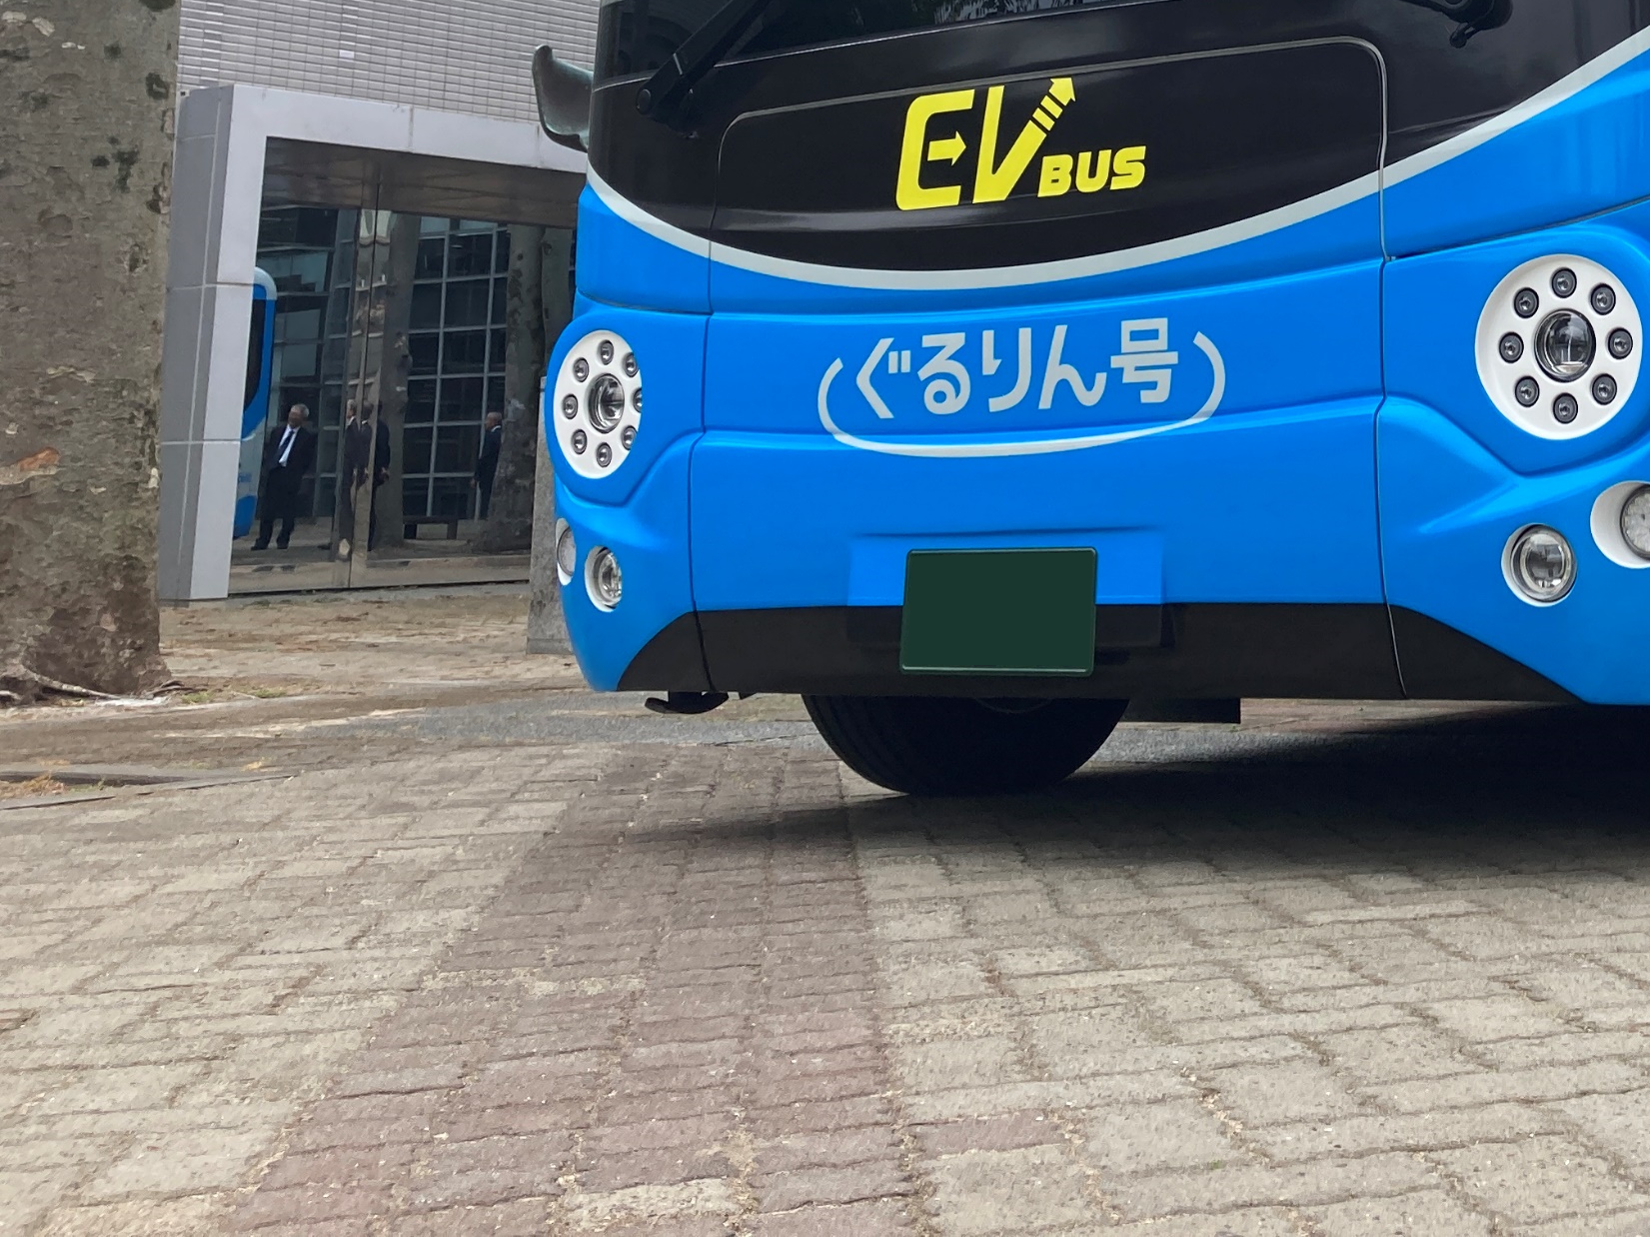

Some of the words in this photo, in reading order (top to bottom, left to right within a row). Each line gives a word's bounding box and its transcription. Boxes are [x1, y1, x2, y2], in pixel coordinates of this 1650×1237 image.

[895, 77, 1077, 211] EV
[1037, 145, 1147, 199] BUS
[853, 317, 1180, 419] ぐるりん号
